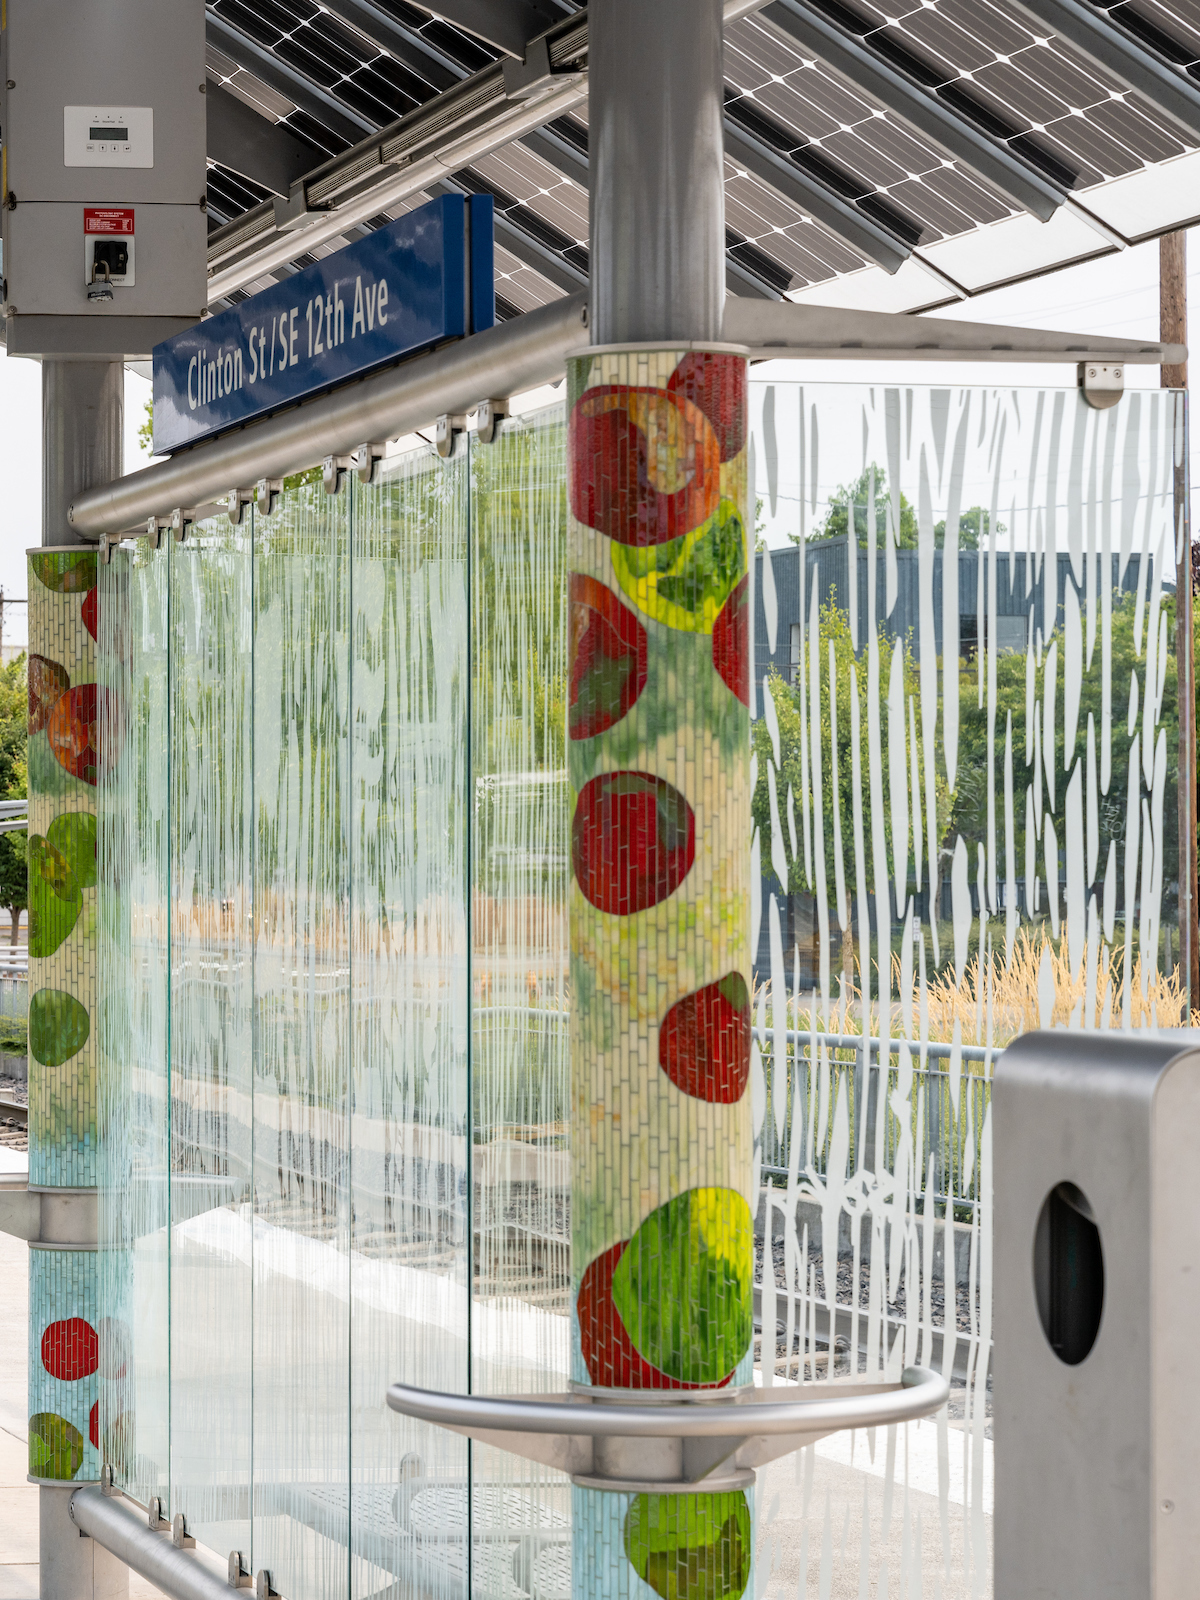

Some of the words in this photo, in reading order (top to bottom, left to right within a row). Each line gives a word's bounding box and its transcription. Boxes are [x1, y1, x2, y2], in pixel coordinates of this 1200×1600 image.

[188, 347, 243, 410] Clinton
[249, 326, 266, 384] St
[278, 306, 299, 371] SE
[305, 282, 345, 358] 12th
[351, 275, 389, 339] Ave
